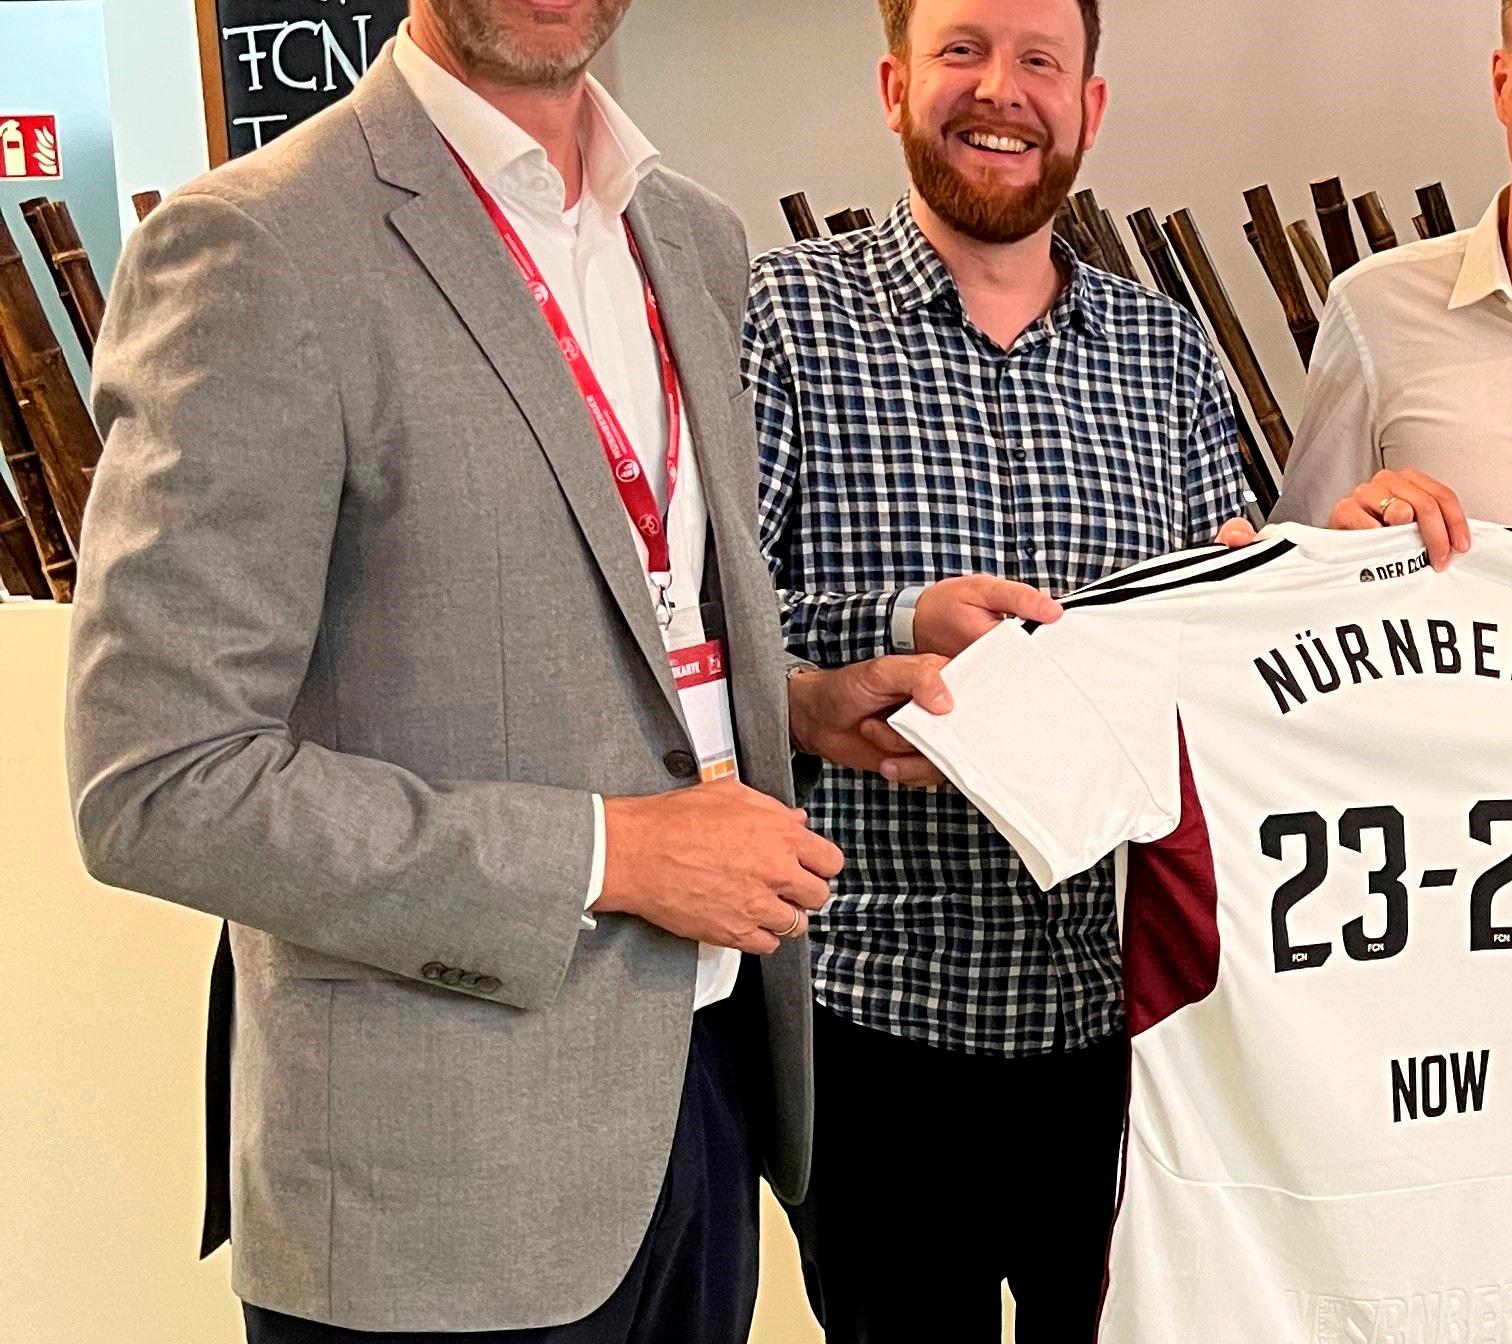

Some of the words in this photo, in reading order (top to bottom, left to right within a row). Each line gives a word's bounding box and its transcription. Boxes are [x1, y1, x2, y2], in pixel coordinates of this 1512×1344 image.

[222, 14, 372, 92] FCN
[1376, 561, 1405, 581] DER
[1493, 932, 1510, 943] FCN
[1367, 942, 1385, 953] FCN
[1292, 952, 1308, 962] FCN
[1390, 1049, 1490, 1123] NOW
